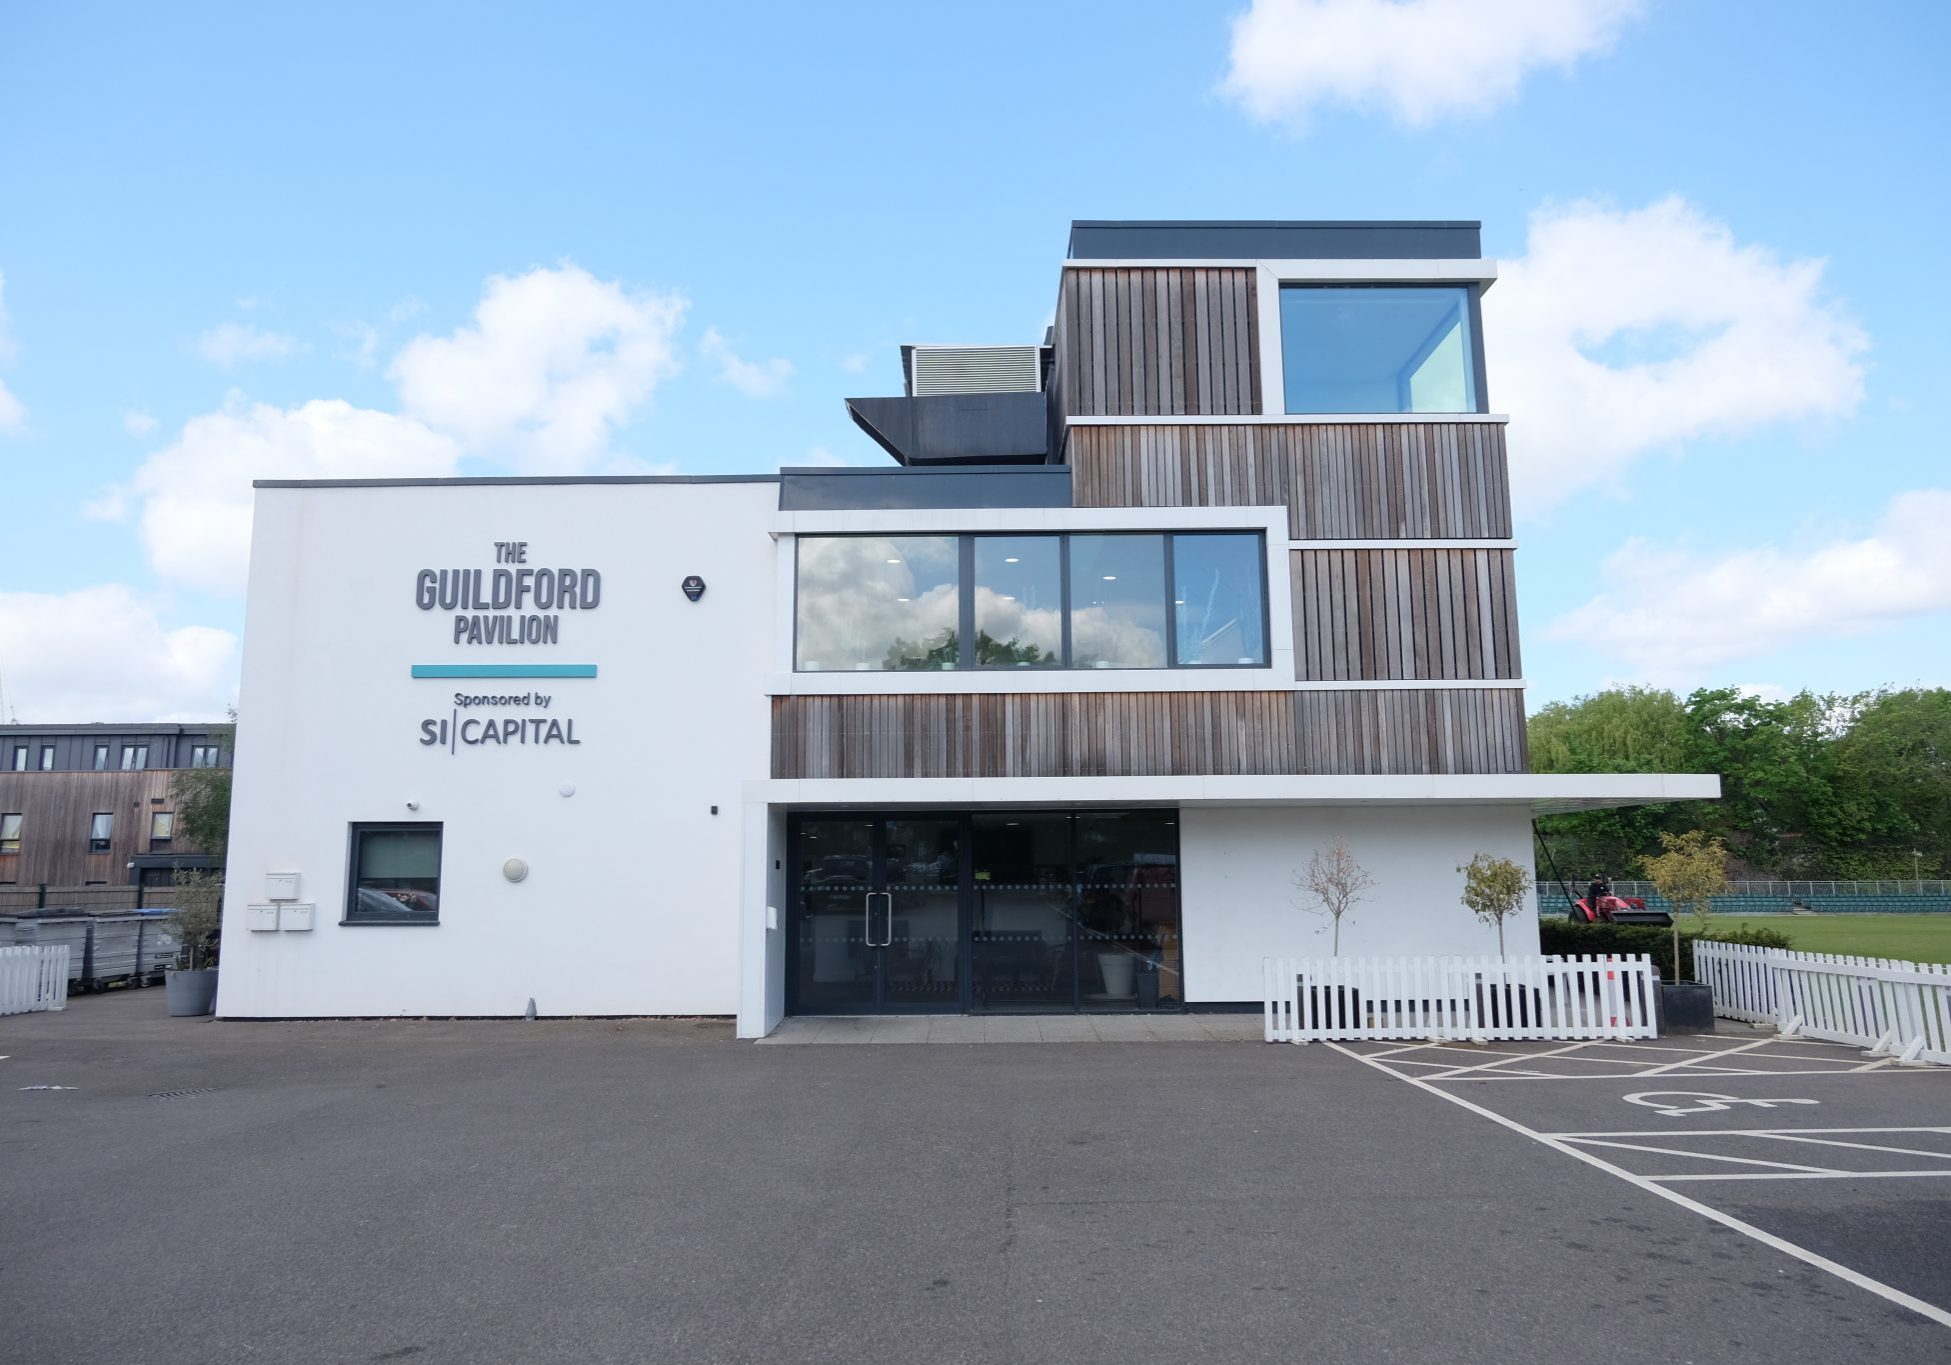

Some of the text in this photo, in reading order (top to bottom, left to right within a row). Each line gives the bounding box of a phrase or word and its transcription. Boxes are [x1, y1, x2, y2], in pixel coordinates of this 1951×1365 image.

[494, 542, 527, 563] THE
[415, 567, 601, 610] GUILDFORD
[453, 614, 559, 644] PAVILION
[453, 691, 552, 708] Sponsored by
